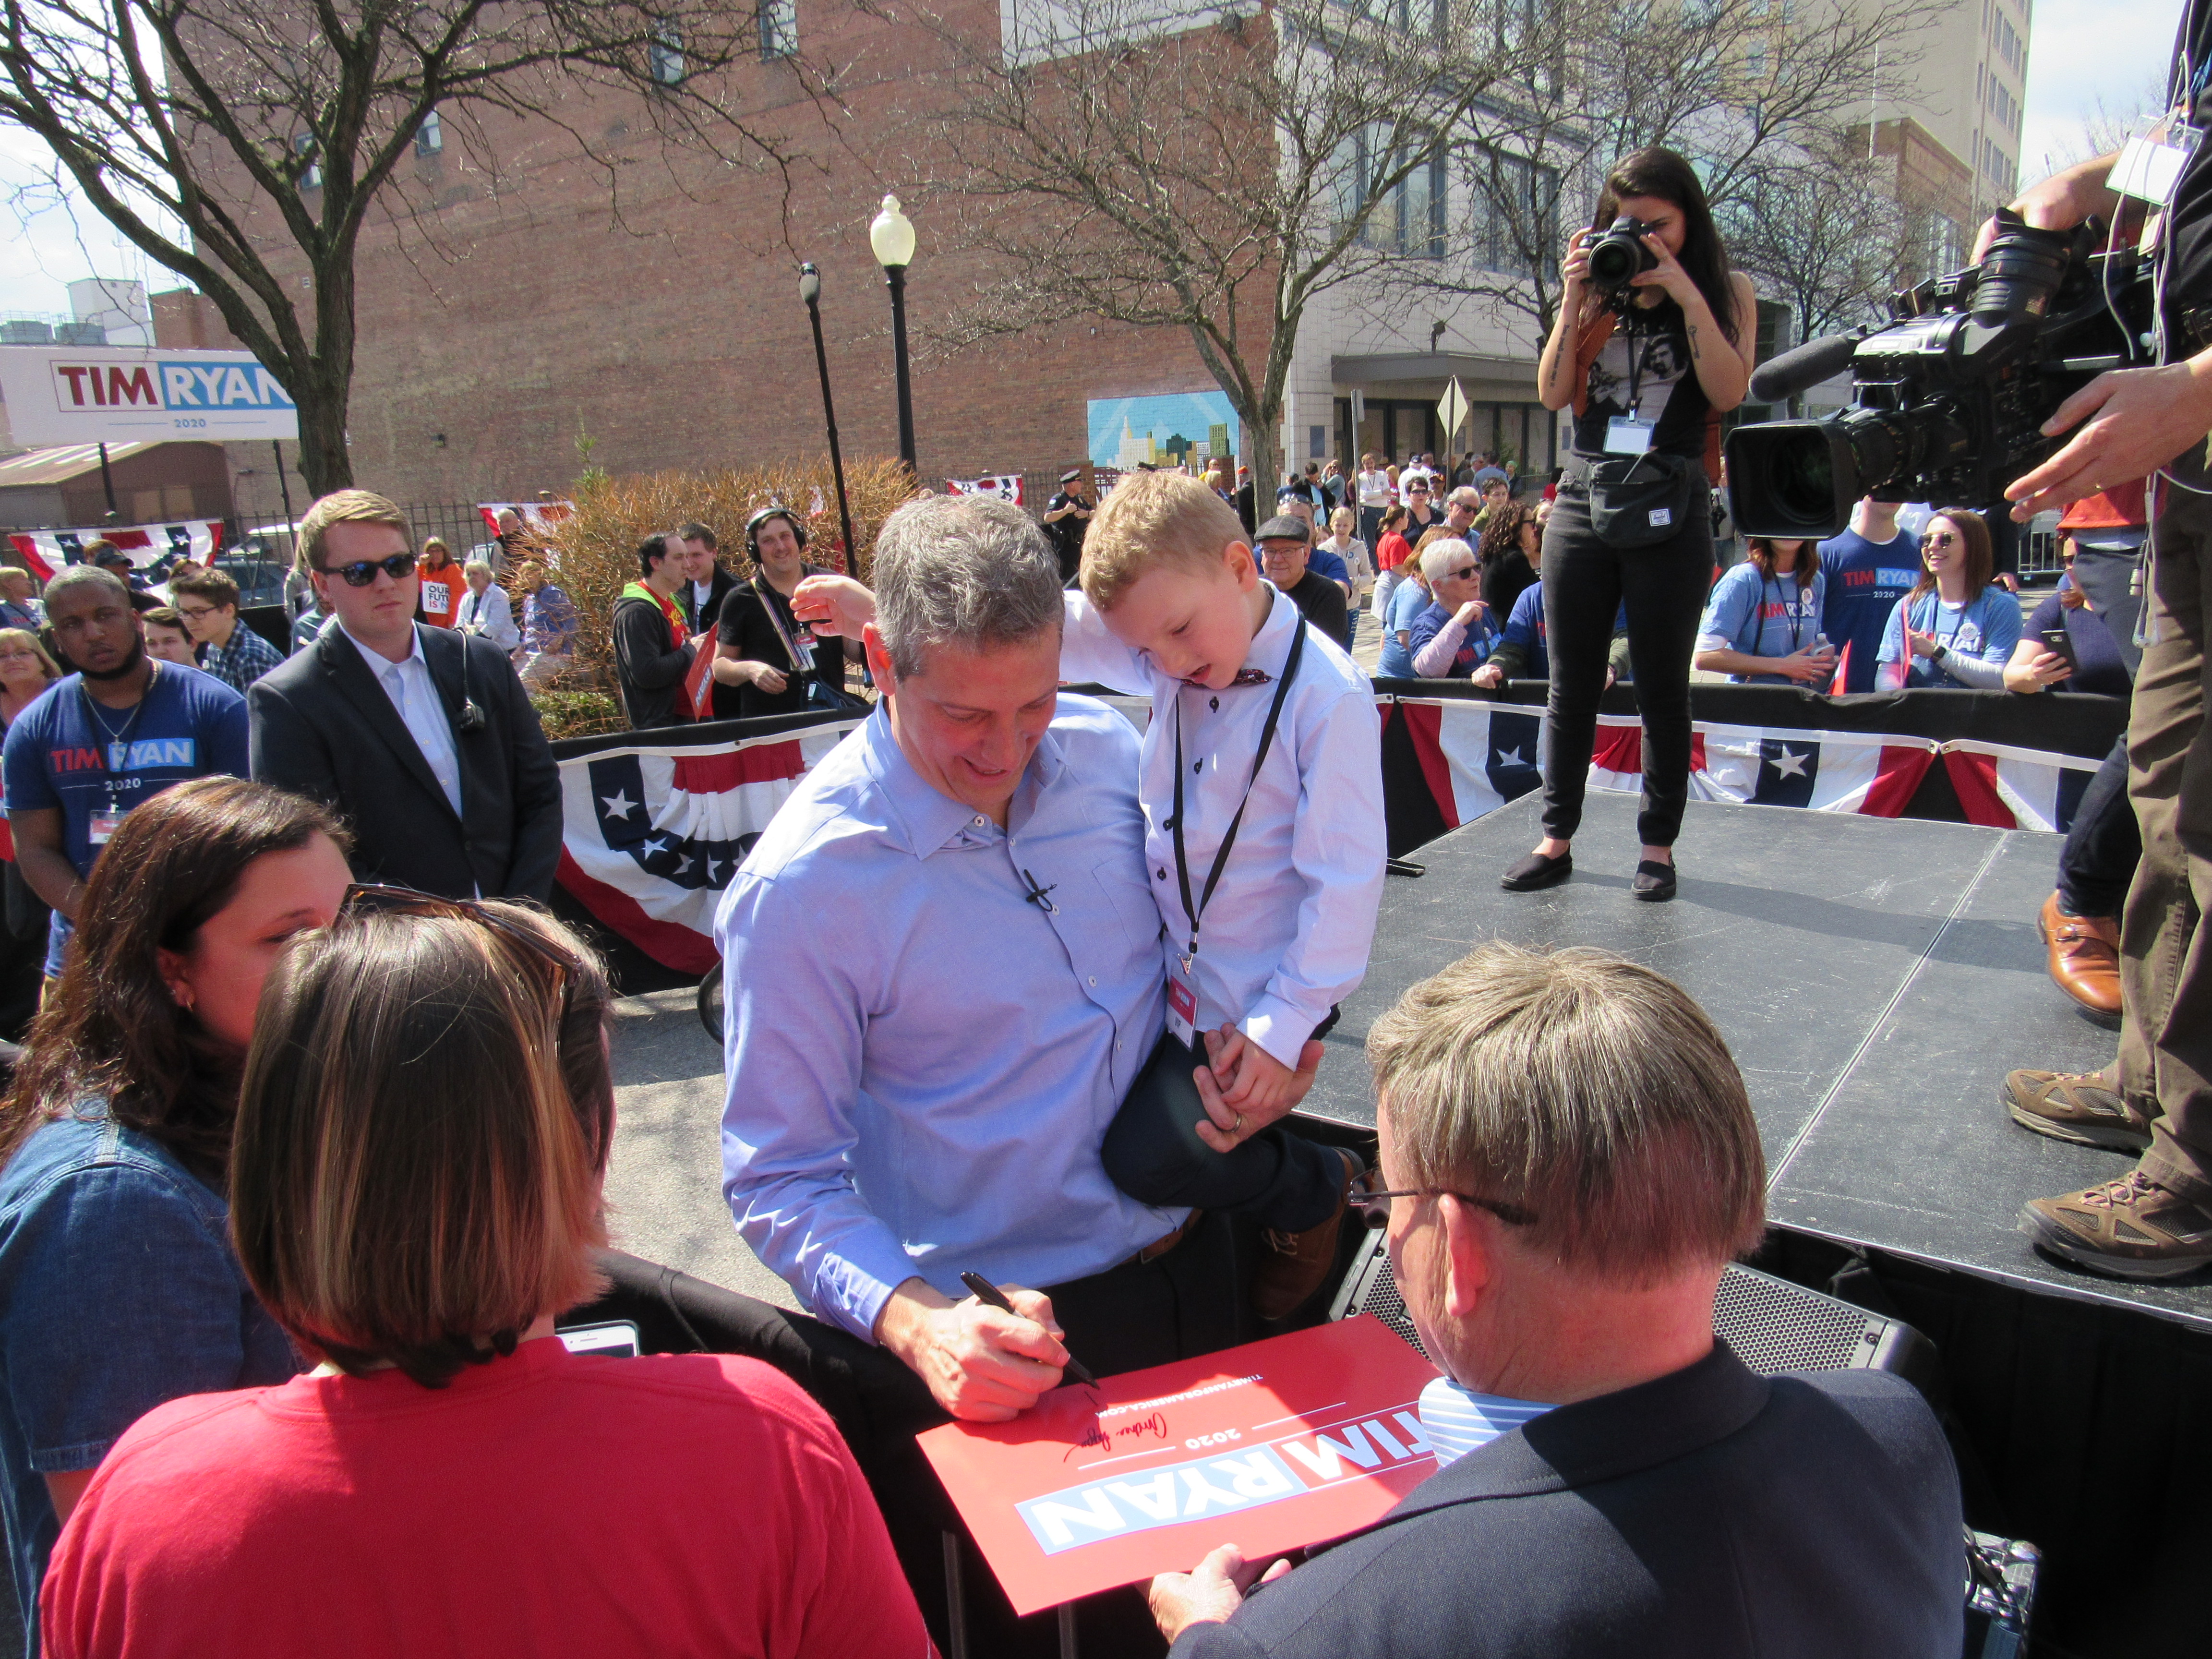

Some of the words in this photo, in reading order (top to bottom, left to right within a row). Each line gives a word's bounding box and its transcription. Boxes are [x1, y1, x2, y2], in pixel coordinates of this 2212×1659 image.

[58, 366, 158, 406] TIM
[174, 419, 206, 428] 2020
[1843, 570, 1875, 586] TIM
[428, 585, 450, 595] OUR
[51, 748, 105, 772] TIM
[104, 778, 141, 791] 2020
[1094, 1373, 1263, 1418] TIMRYANFORAMERICA.COM
[1184, 1428, 1241, 1450] 2020
[1281, 1410, 1434, 1480] TIM
[1030, 1451, 1294, 1547] RYAN
